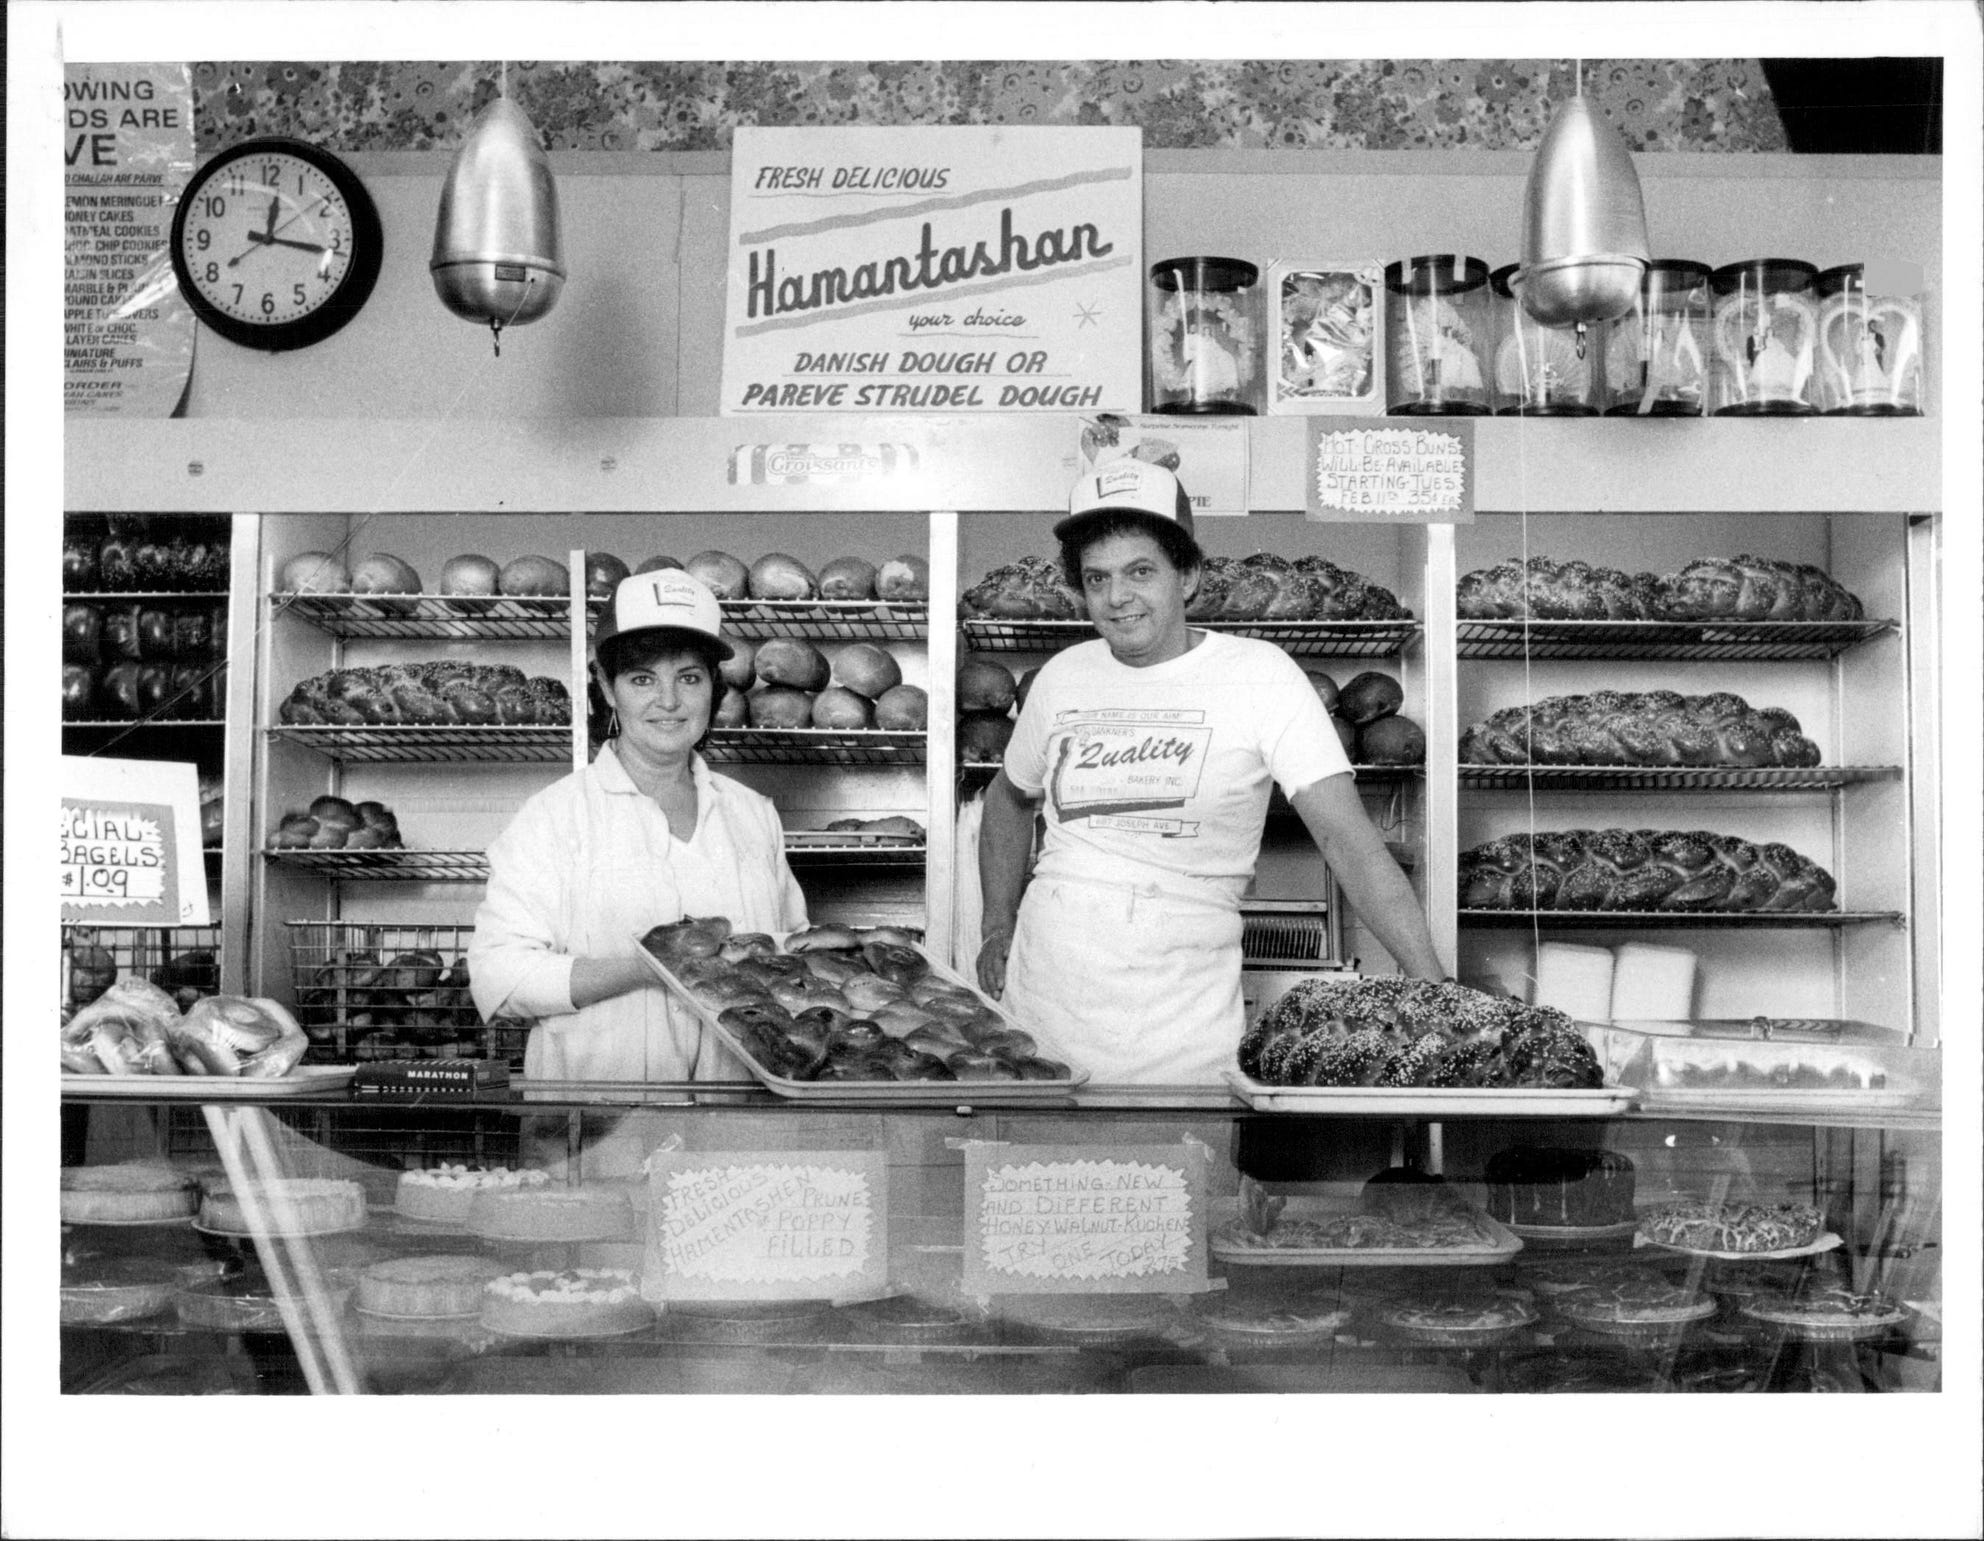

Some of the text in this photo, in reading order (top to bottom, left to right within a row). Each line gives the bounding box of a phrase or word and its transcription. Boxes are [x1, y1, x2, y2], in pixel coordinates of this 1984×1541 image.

[120, 109, 179, 128] ARE
[231, 174, 245, 196] 11
[263, 164, 281, 186] 12
[298, 174, 304, 196] 1
[754, 167, 951, 189] FRESH DELICIOUS
[99, 211, 134, 222] CAKES
[206, 196, 226, 218] 10
[114, 226, 160, 237] COOKIES
[197, 229, 211, 251] 9
[95, 241, 120, 252] CHIP
[206, 262, 219, 283] 8
[747, 207, 1114, 319] Hamantashan
[232, 284, 243, 305] 7
[261, 293, 275, 314] 6
[294, 284, 306, 306] 5
[909, 307, 1026, 331] your choice
[111, 358, 144, 368] PUFFS
[793, 350, 1049, 374] DANISH DOUGH OR
[741, 383, 1102, 408] PAREVE STRUDEL DOUGH
[1323, 434, 1460, 455] HOT CROSS BUNS
[1363, 455, 1382, 473] BE
[1410, 474, 1456, 490] TUES
[1341, 489, 1372, 505] FEB
[1074, 736, 1196, 770] Quality
[407, 1070, 469, 1080] MARATHON
[1117, 1173, 1163, 1190] NEW
[802, 1187, 866, 1208] PRUNE
[986, 1199, 1023, 1215] AND
[777, 1209, 851, 1232] POPPY
[999, 1237, 1046, 1266] TRY
